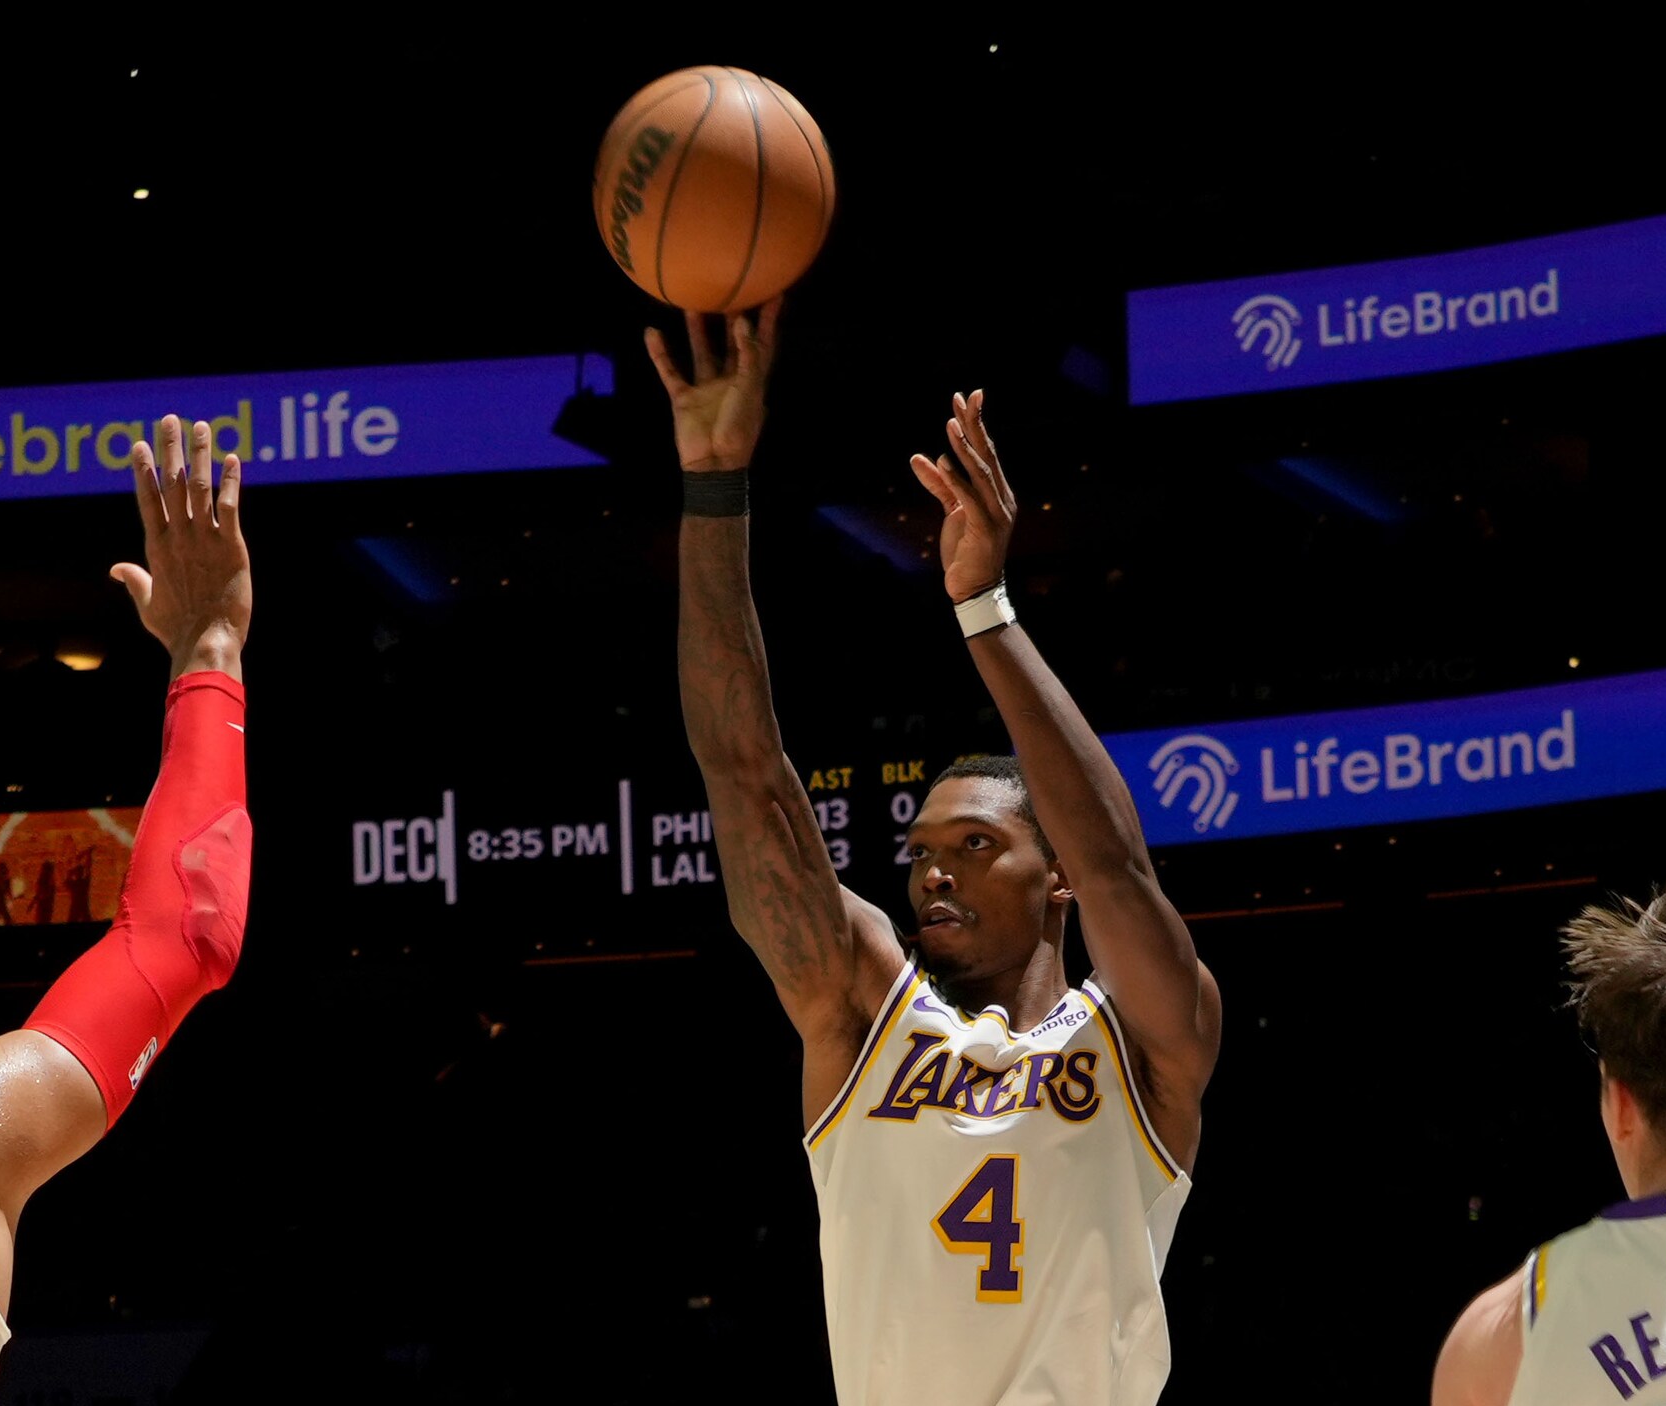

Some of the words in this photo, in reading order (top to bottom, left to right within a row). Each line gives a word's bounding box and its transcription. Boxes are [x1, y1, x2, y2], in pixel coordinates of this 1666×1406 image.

[1318, 269, 1558, 347] LifeBrand
[808, 766, 854, 791] AST
[882, 760, 925, 785] BLK
[1260, 710, 1575, 802] LifeBrand
[467, 829, 544, 861] 8:35
[552, 824, 609, 857] PM
[652, 811, 711, 847] PHI
[814, 798, 850, 831] 13
[891, 792, 916, 825] 0
[652, 848, 716, 886] LAL
[829, 838, 851, 871] 3
[866, 1028, 1101, 1124] LAKERS
[930, 1153, 1025, 1303] 4
